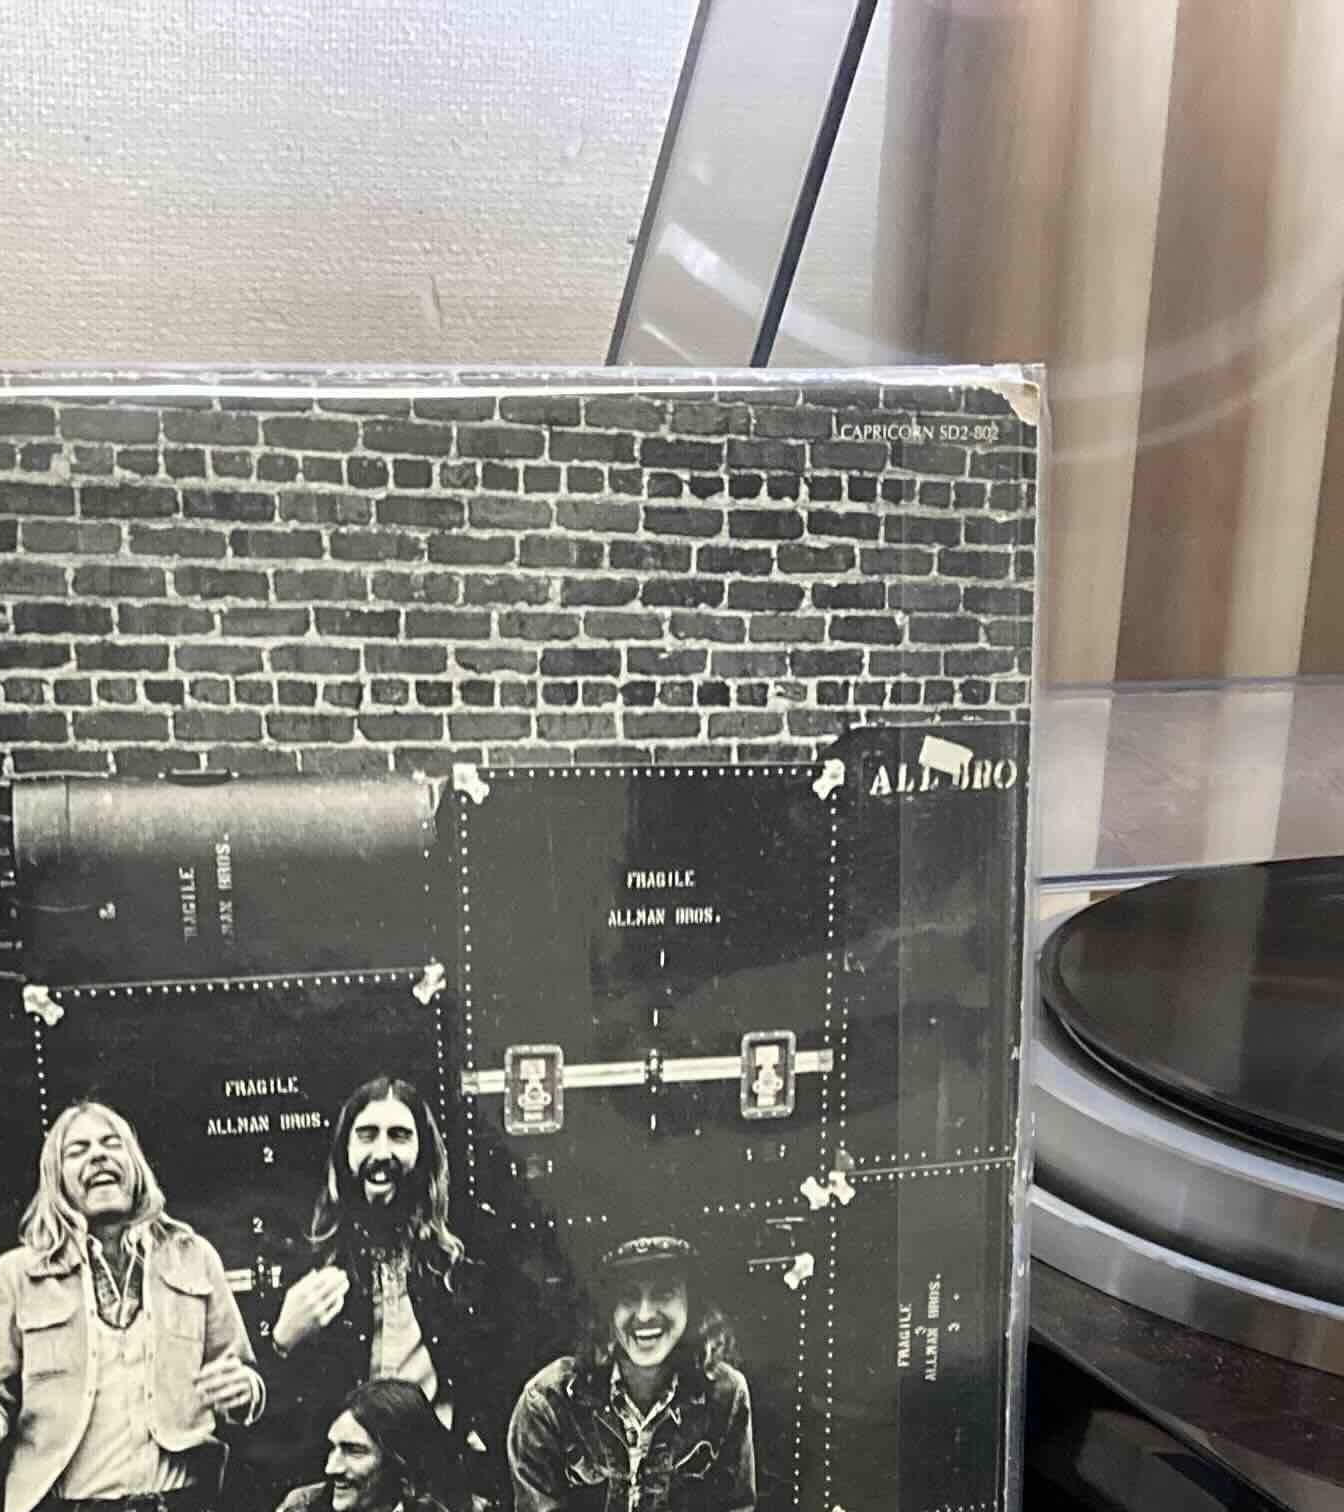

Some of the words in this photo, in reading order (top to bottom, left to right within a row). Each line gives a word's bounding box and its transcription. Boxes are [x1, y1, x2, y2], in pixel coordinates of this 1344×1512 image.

[841, 422, 935, 441] CAPRICORN
[939, 424, 1000, 441] SD2-802
[626, 869, 695, 889] FRAGILE
[607, 908, 666, 928] ALLMAN
[675, 906, 721, 925] BROS.
[225, 1075, 299, 1097] FRAGILE
[207, 1114, 270, 1136] ALLMAN
[279, 1111, 330, 1131] BROS.
[263, 1146, 274, 1163] 2
[252, 1217, 263, 1233] 2
[259, 1320, 270, 1337] 2
[896, 1303, 912, 1368] FRAGILE
[924, 1328, 939, 1381] ALLMAN
